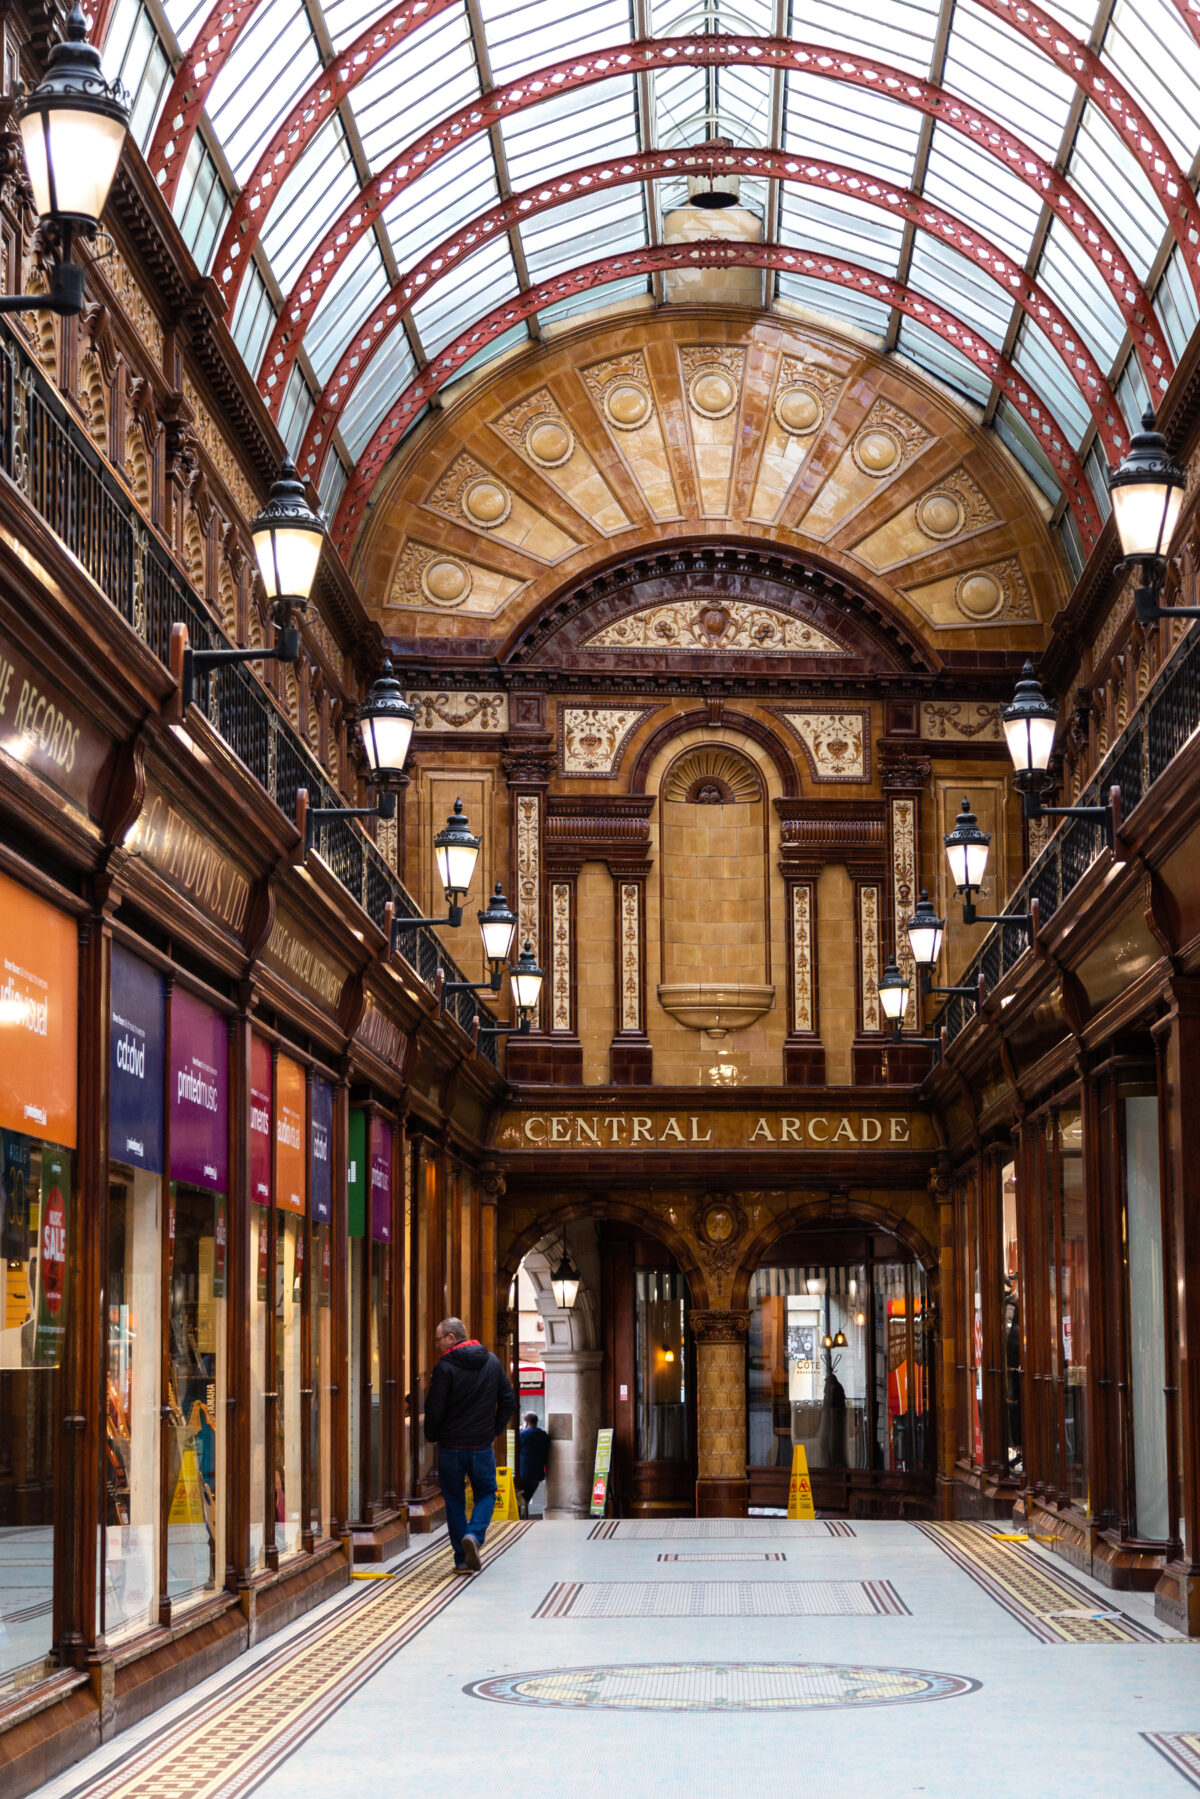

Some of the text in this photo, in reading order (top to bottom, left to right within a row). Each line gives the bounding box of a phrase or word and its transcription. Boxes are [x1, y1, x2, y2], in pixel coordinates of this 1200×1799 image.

[14, 679, 80, 773] RECORDS
[116, 1033, 145, 1079] cd:dvd
[178, 1065, 218, 1113] printedmusic
[524, 1116, 910, 1142] CENTRAL ARCADE
[43, 1225, 66, 1262] SALE
